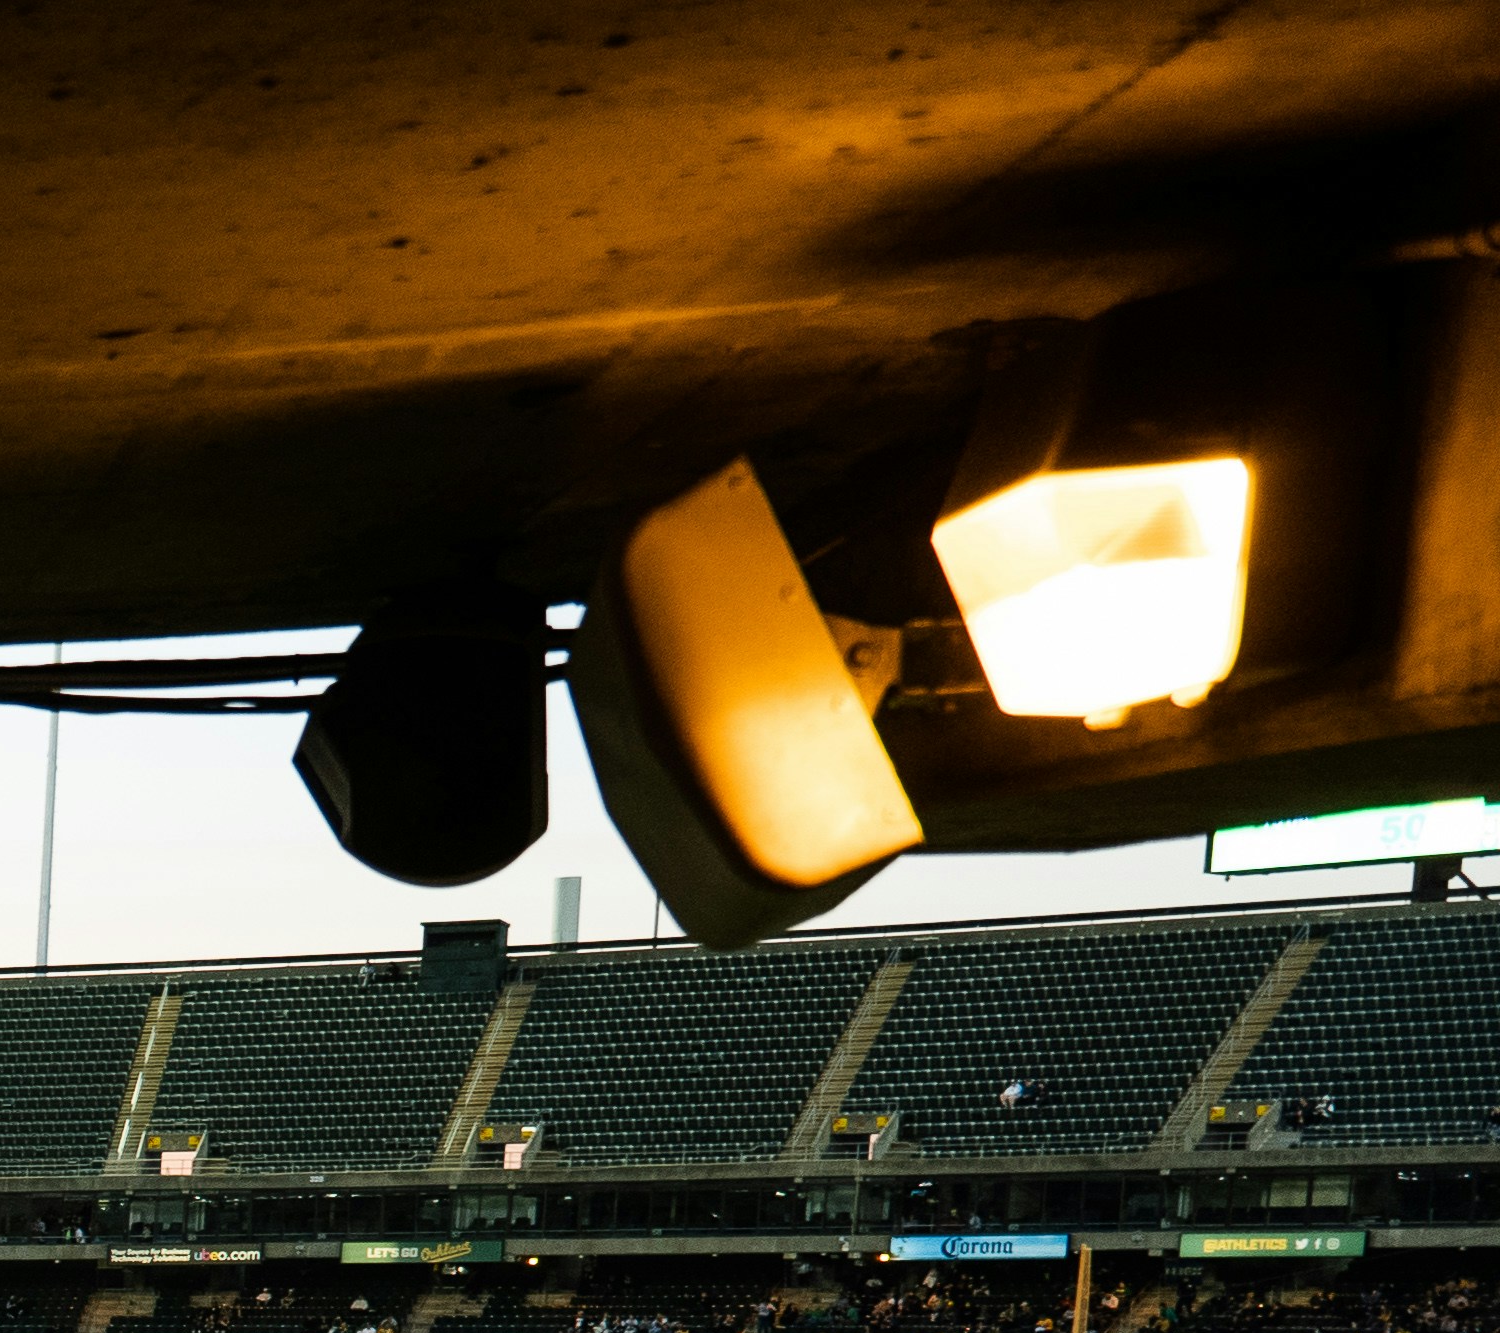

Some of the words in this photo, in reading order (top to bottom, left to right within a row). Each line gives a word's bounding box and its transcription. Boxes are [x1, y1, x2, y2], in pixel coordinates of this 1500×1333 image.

[366, 1247, 399, 1259] LET'S
[401, 1247, 419, 1258] GO
[420, 1241, 472, 1262] Oakland
[940, 1236, 1014, 1259] Corona
[1202, 1237, 1288, 1253] @ATHLETICS
[194, 1248, 261, 1263] ubeo.com
